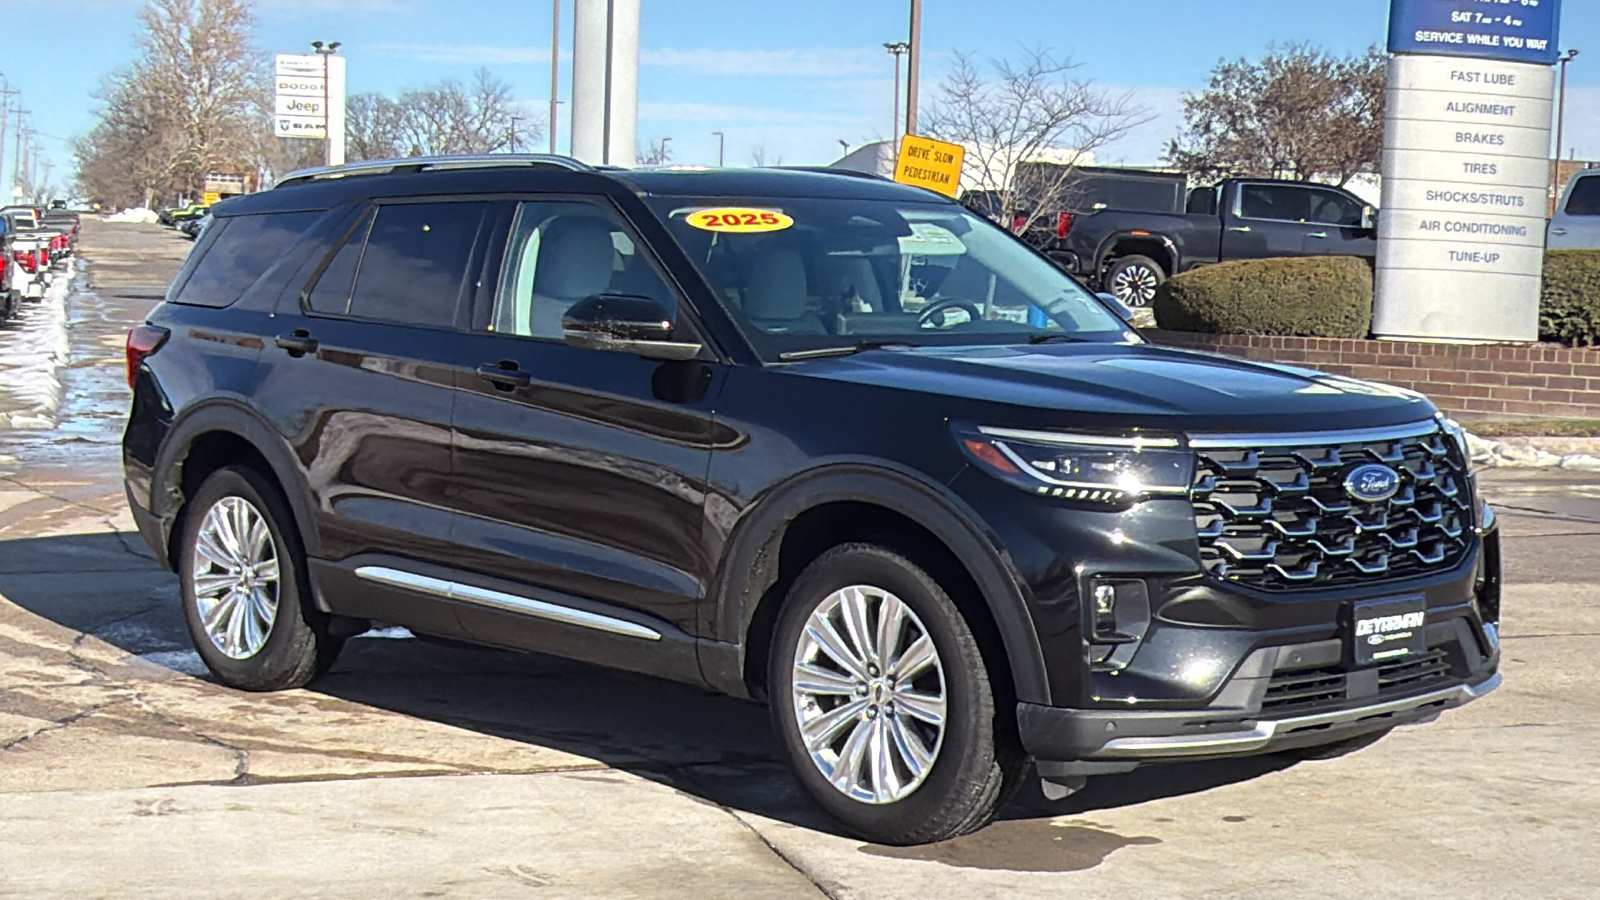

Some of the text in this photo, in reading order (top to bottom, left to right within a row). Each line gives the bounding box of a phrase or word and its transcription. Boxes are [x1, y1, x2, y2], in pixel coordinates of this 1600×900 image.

[1451, 11, 1473, 22] SAT
[1415, 30, 1548, 50] SERVICE WHILE YOU WAIT
[1450, 70, 1515, 85] FAST LUBE
[287, 99, 320, 114] Jeep
[1446, 102, 1515, 116] ALIGNMENT
[1455, 132, 1504, 145] BRAKES
[907, 145, 954, 164] DRIVE SLOW
[903, 165, 950, 185] PEDESTRIAN
[1463, 162, 1497, 175] TIRES
[1426, 190, 1524, 207] SHOCKS/STRUTS
[701, 213, 780, 227] 2025
[1419, 220, 1527, 237] AIR CONDITIONING
[1448, 250, 1500, 263] TUNE-UP
[1360, 472, 1390, 491] Ford
